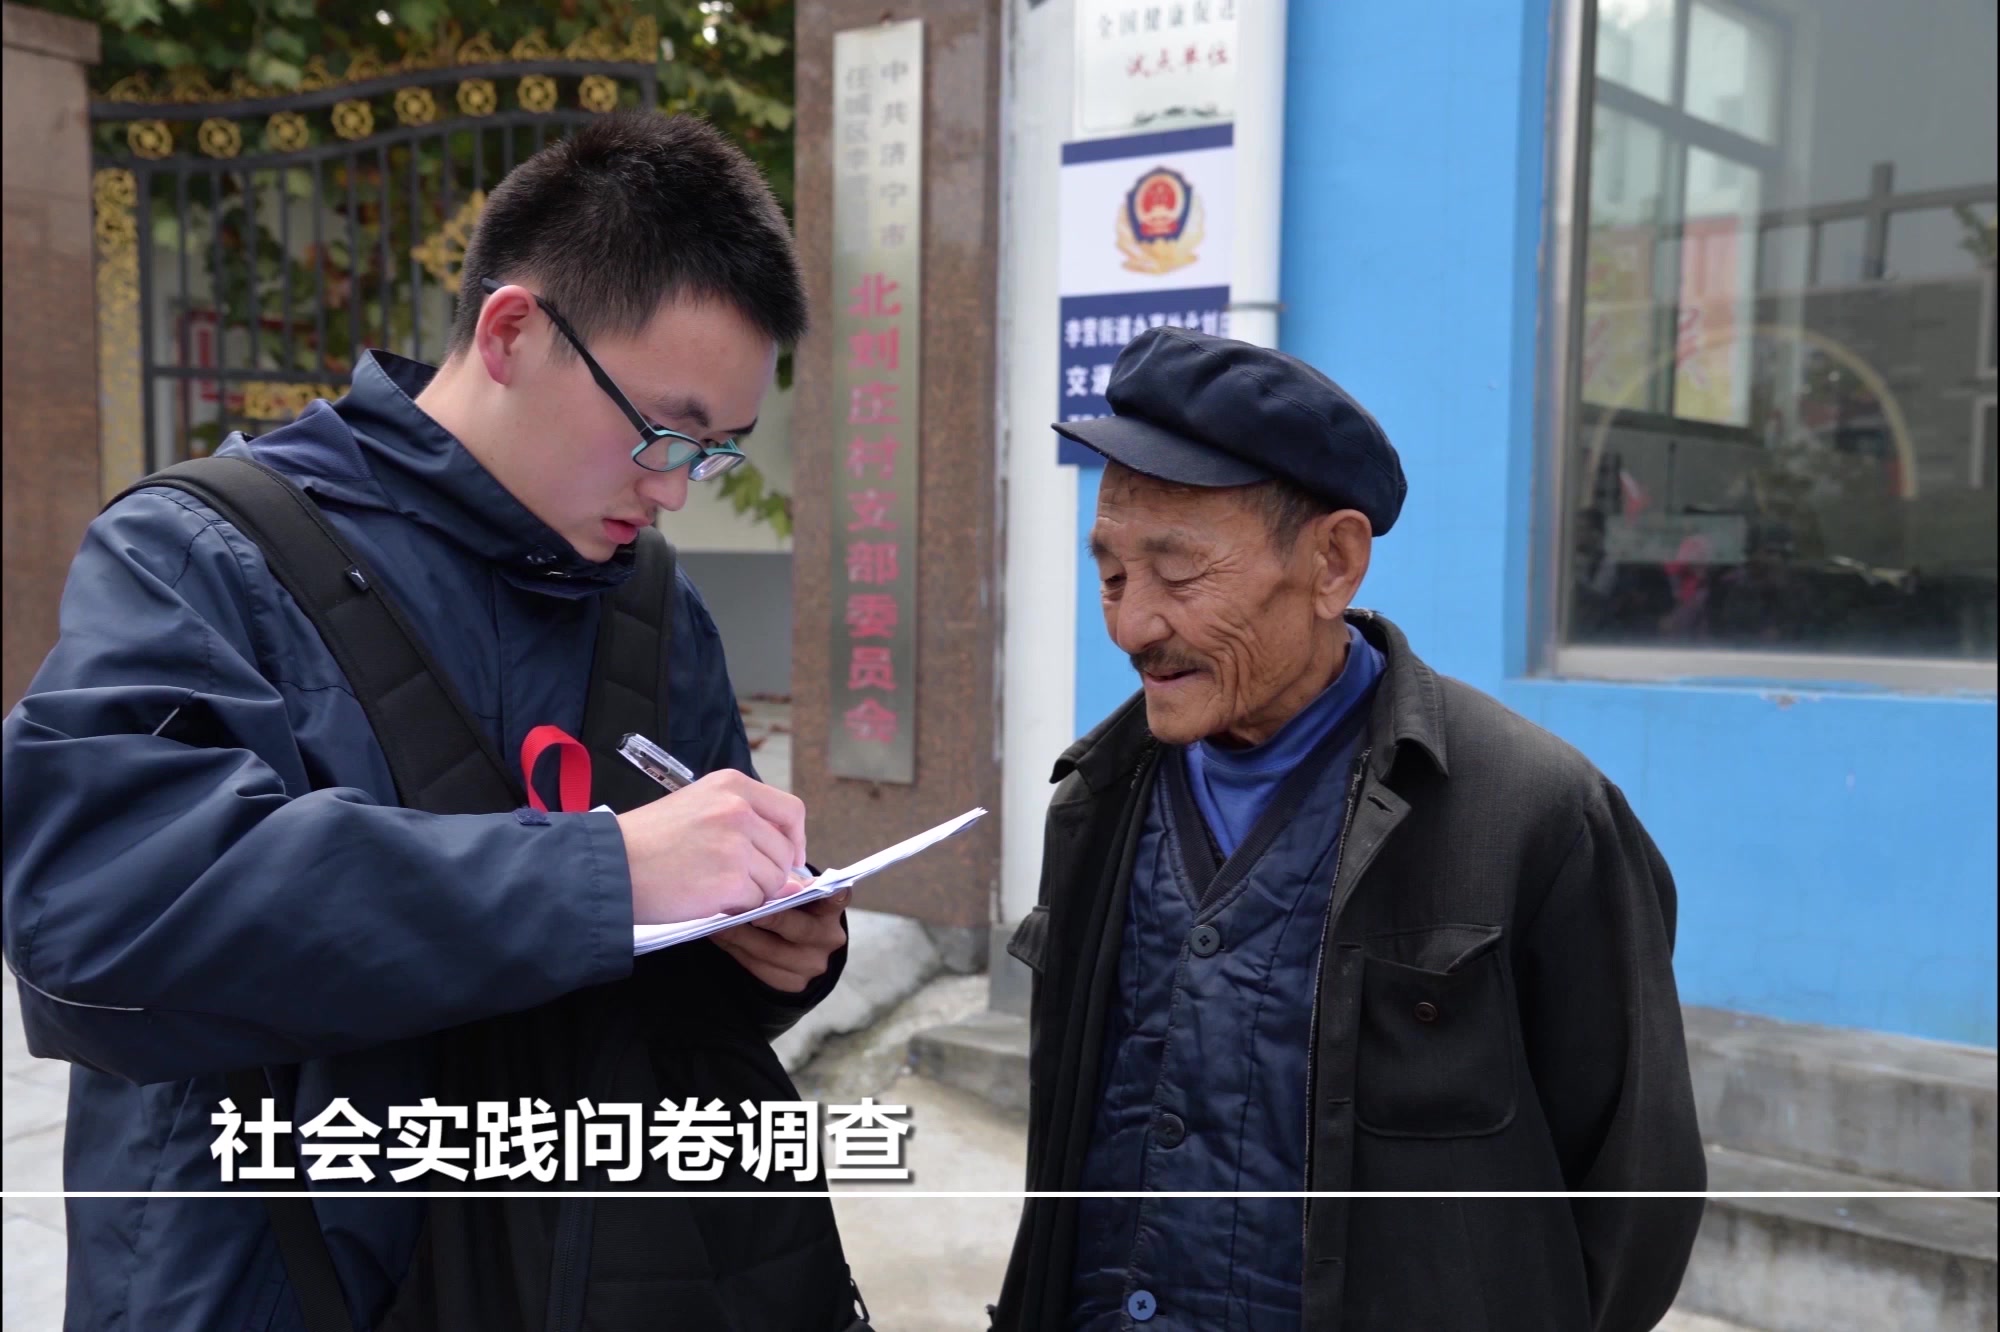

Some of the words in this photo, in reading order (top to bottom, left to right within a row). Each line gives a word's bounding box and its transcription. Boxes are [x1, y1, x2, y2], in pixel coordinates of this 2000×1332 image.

[845, 271, 904, 742] 北刘庄村支部委员会
